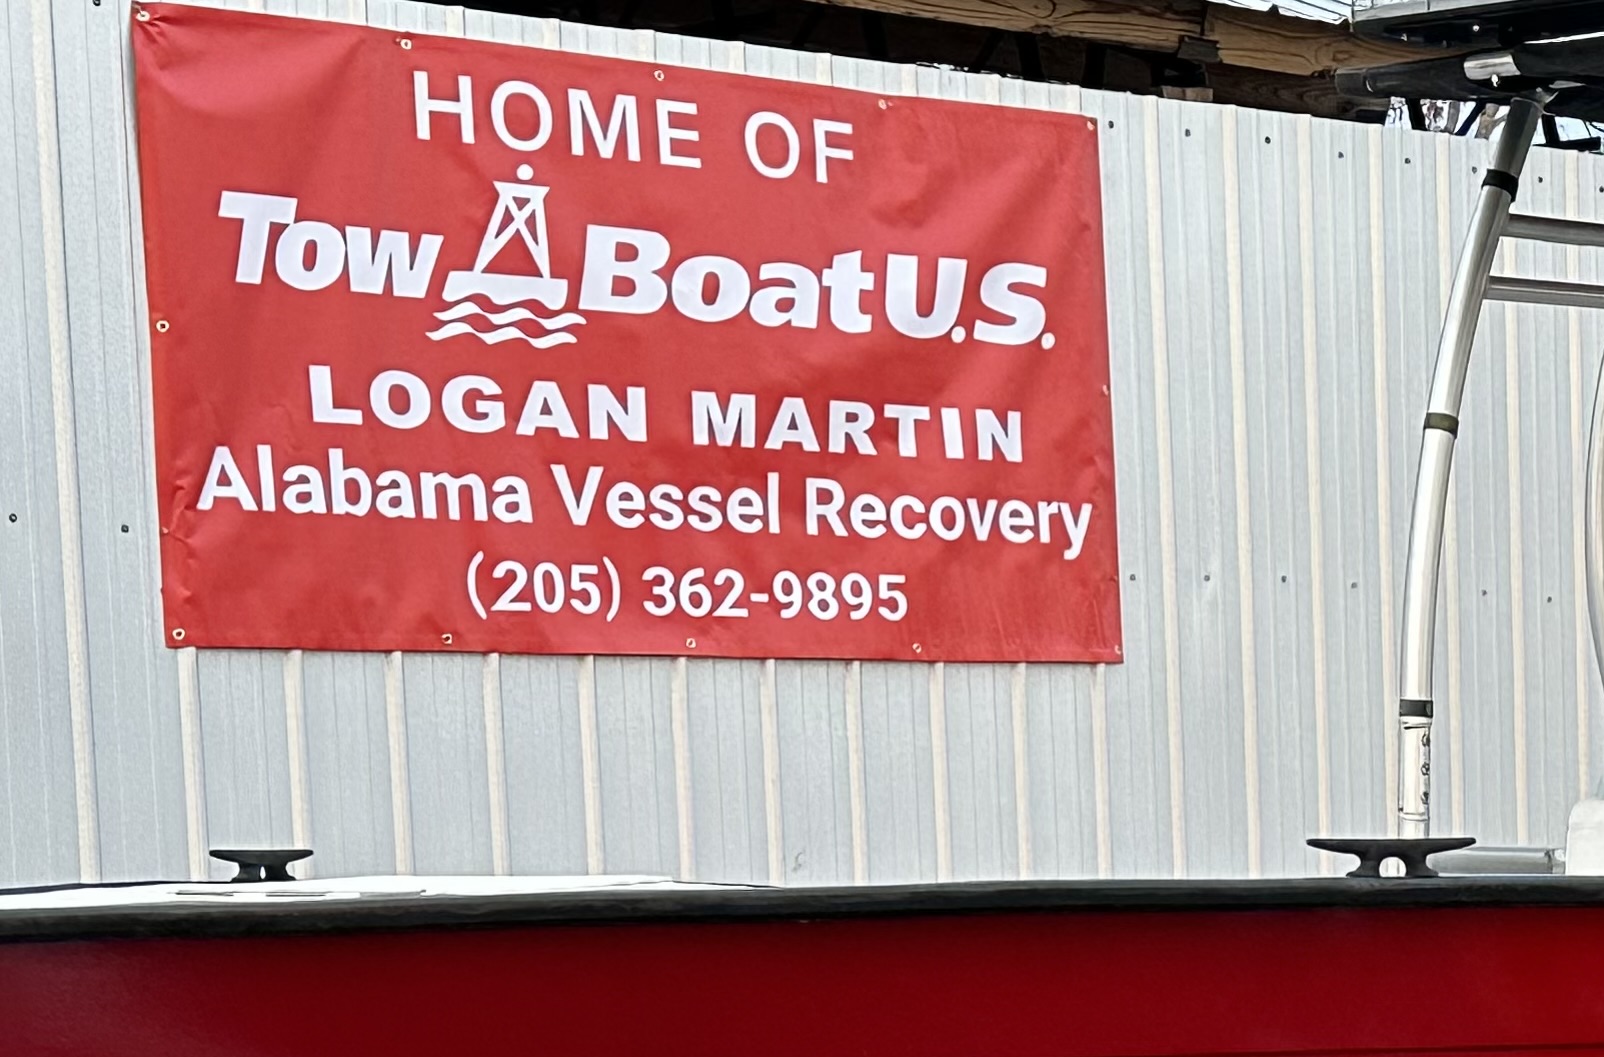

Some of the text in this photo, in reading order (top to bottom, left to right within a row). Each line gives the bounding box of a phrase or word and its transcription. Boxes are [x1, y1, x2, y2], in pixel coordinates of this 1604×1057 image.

[413, 70, 855, 185] HOME OF
[218, 190, 445, 299] Tow
[308, 364, 1024, 464] LOGAN MARTIN
[196, 444, 1093, 562] Alabama Vessel Recovery
[467, 550, 909, 623] (205) 362-9895
